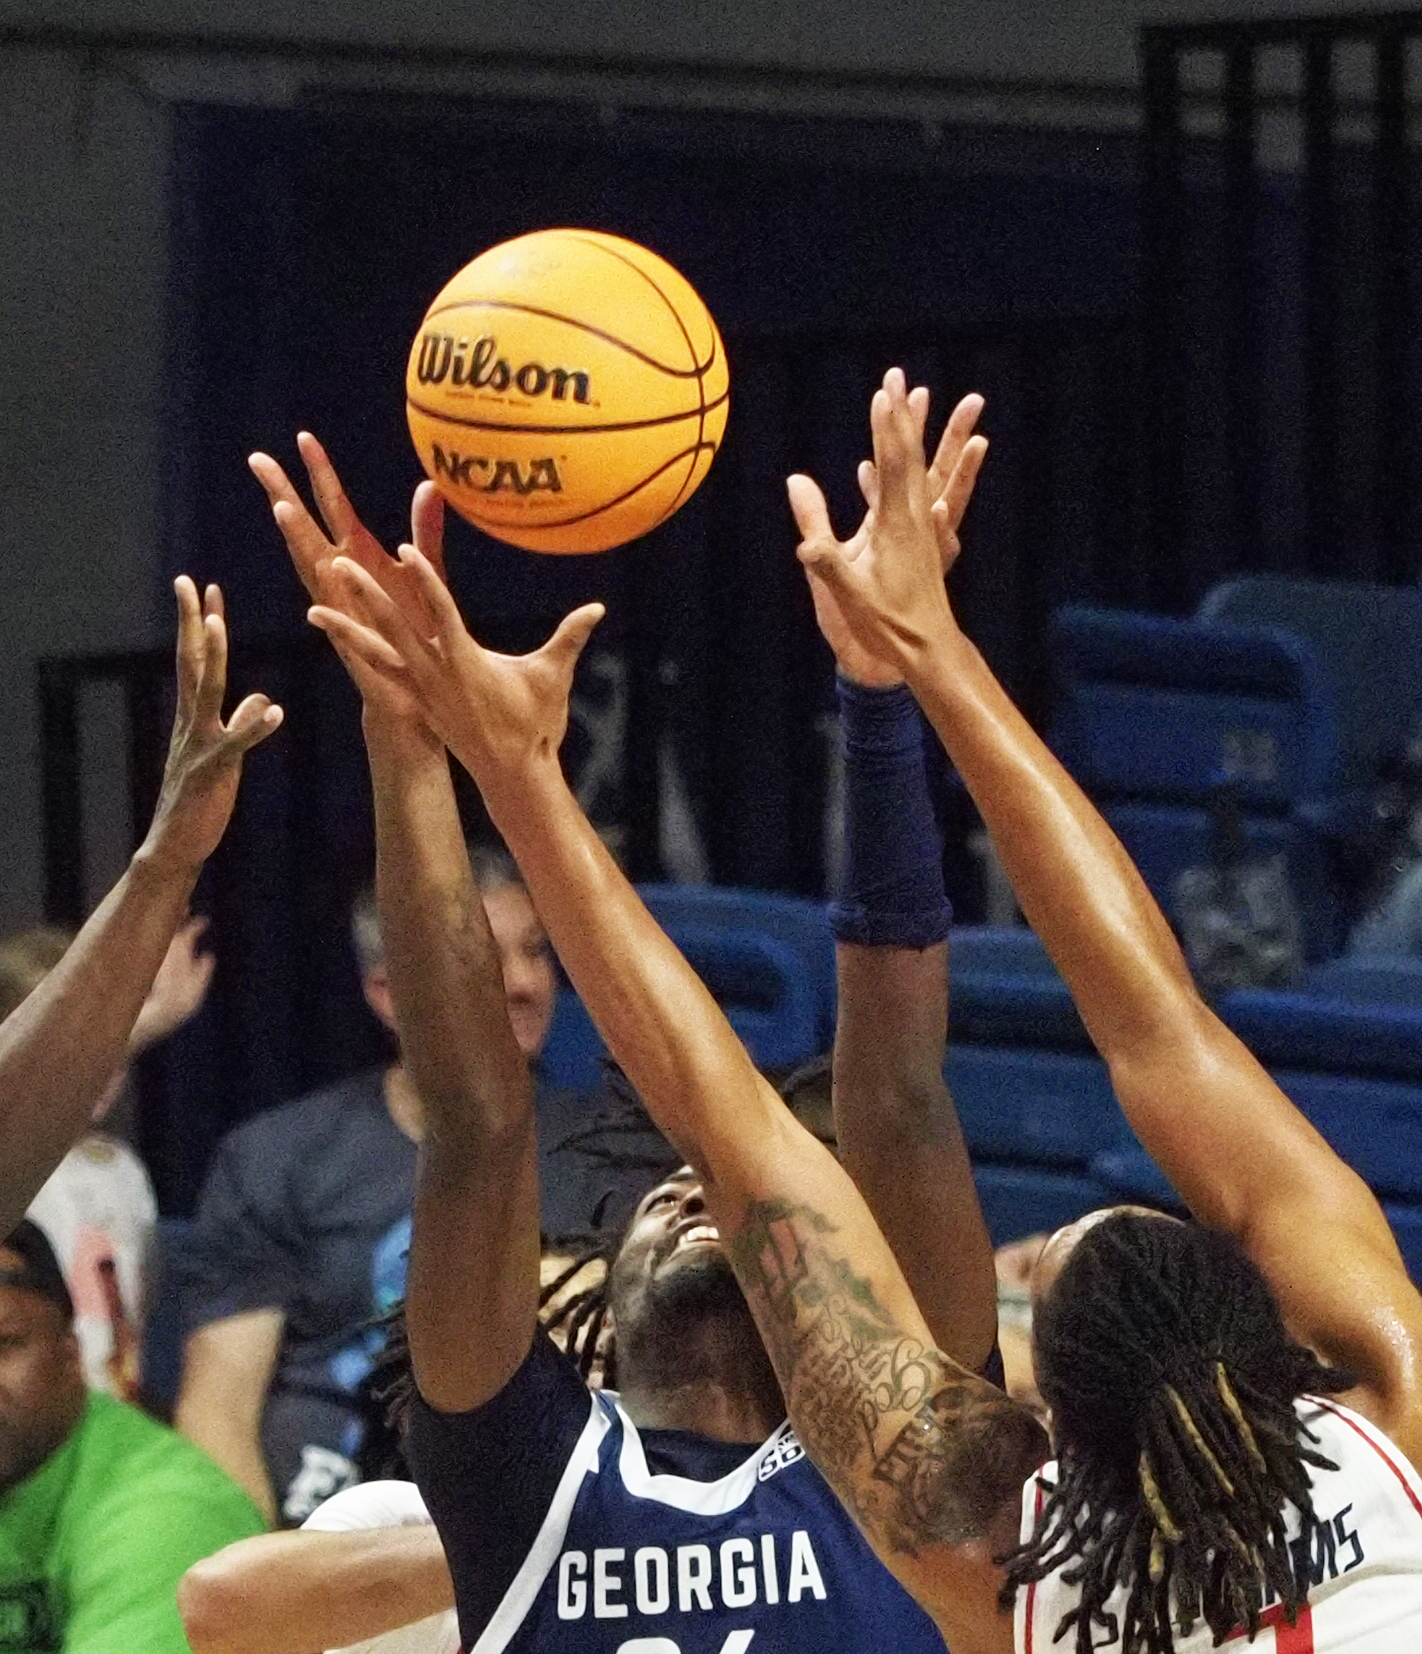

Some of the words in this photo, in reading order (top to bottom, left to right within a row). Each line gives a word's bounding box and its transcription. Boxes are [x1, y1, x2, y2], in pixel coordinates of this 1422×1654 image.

[417, 333, 590, 405] Wilson
[432, 443, 563, 495] NCAA
[557, 1530, 828, 1620] GEORGIA
